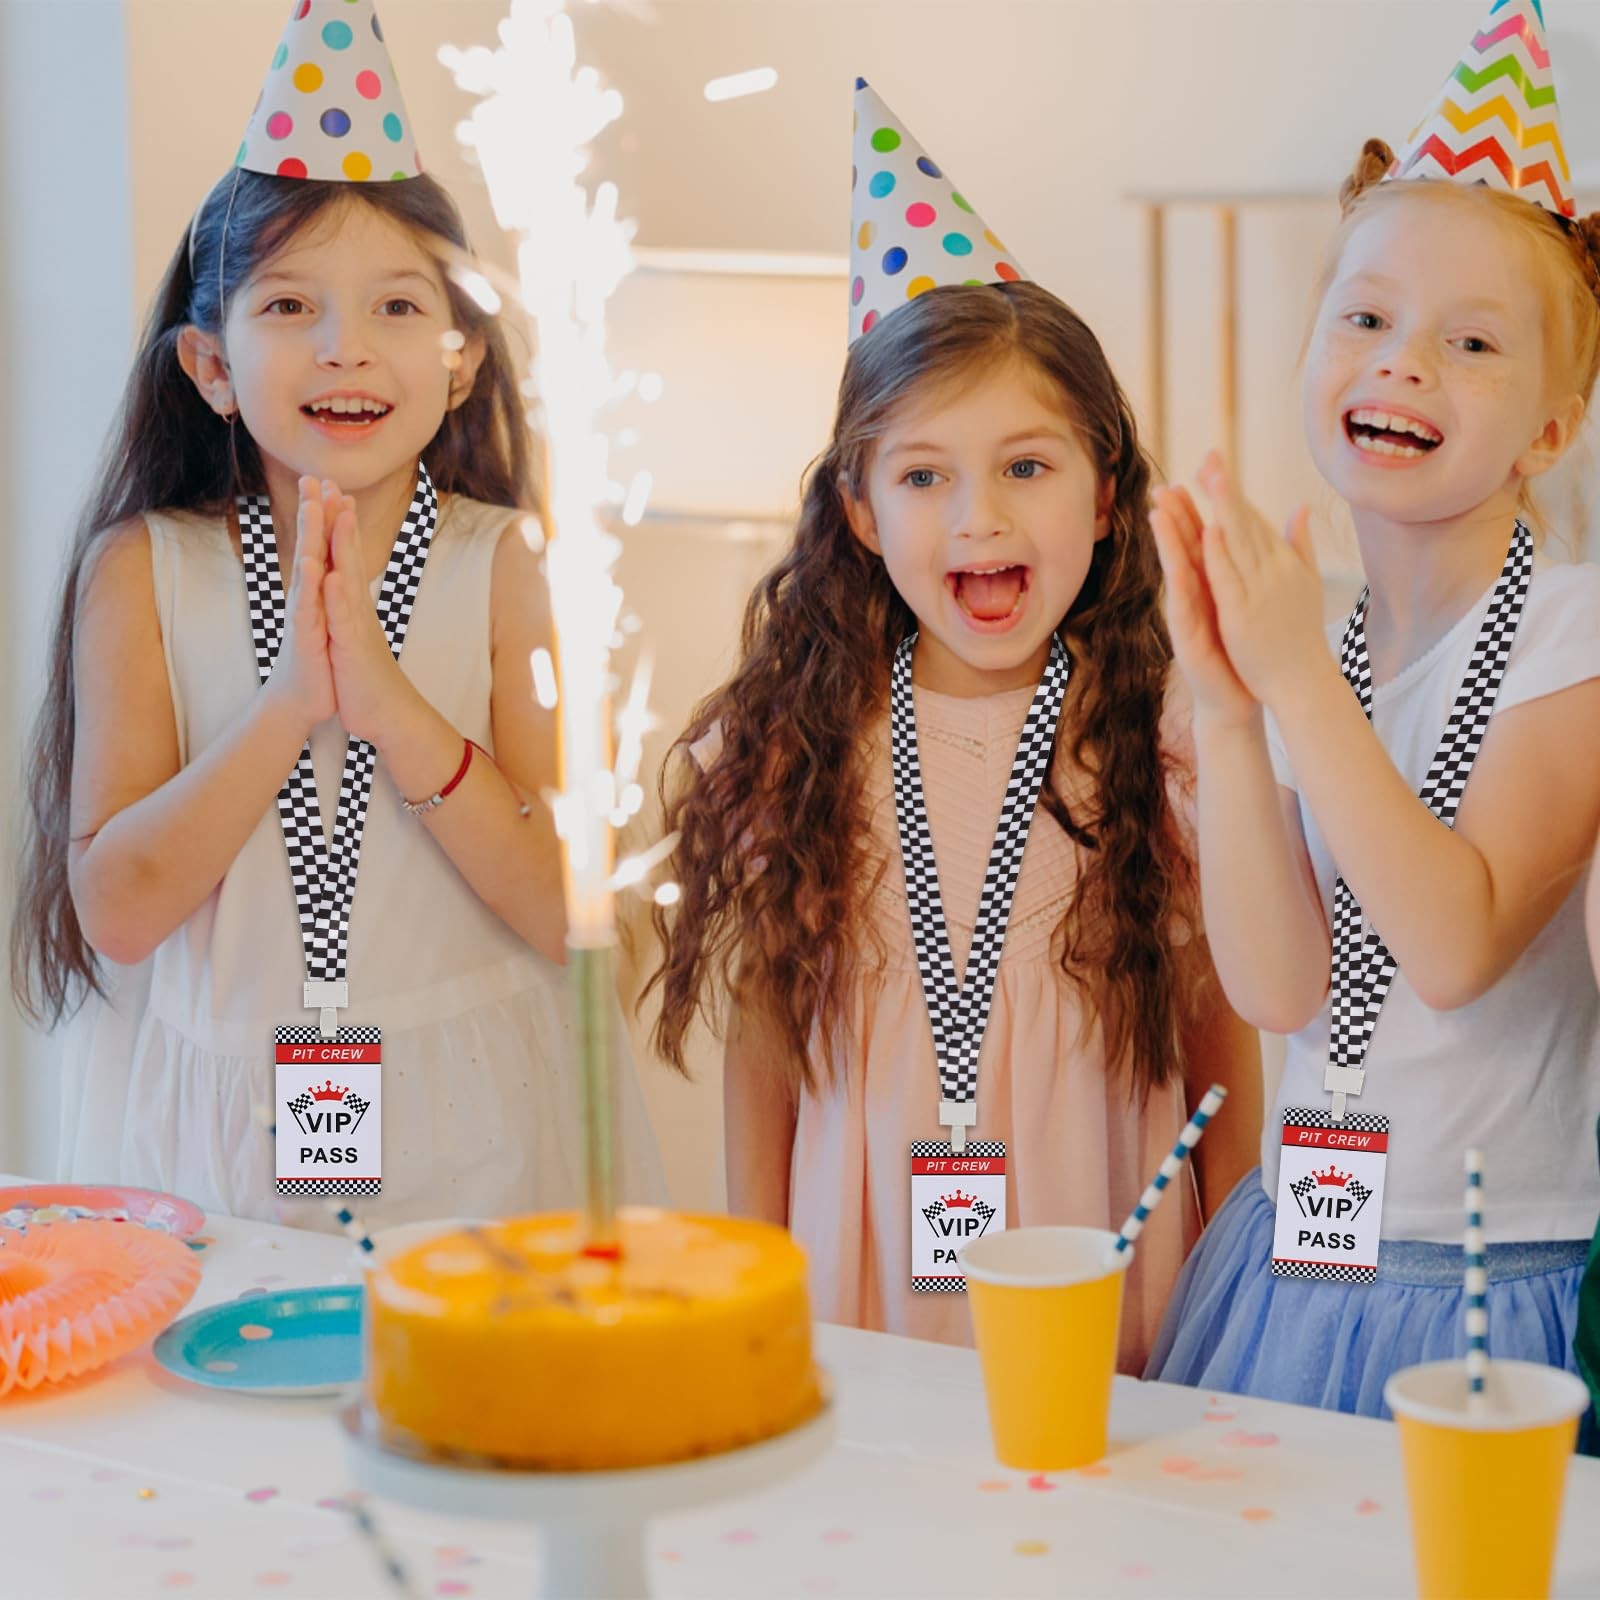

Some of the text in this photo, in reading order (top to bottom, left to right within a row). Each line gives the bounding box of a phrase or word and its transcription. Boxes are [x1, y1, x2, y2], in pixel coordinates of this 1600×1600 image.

[292, 1048, 364, 1060] PIT CREW
[305, 1112, 351, 1133] VIP
[1298, 1131, 1371, 1147] PIT CREW
[300, 1147, 358, 1164] PASS
[926, 1161, 990, 1171] PIT CREW
[1307, 1195, 1352, 1219] VIP
[938, 1218, 979, 1237] VIP
[1298, 1230, 1356, 1251] PASS
[933, 1249, 958, 1264] PA
